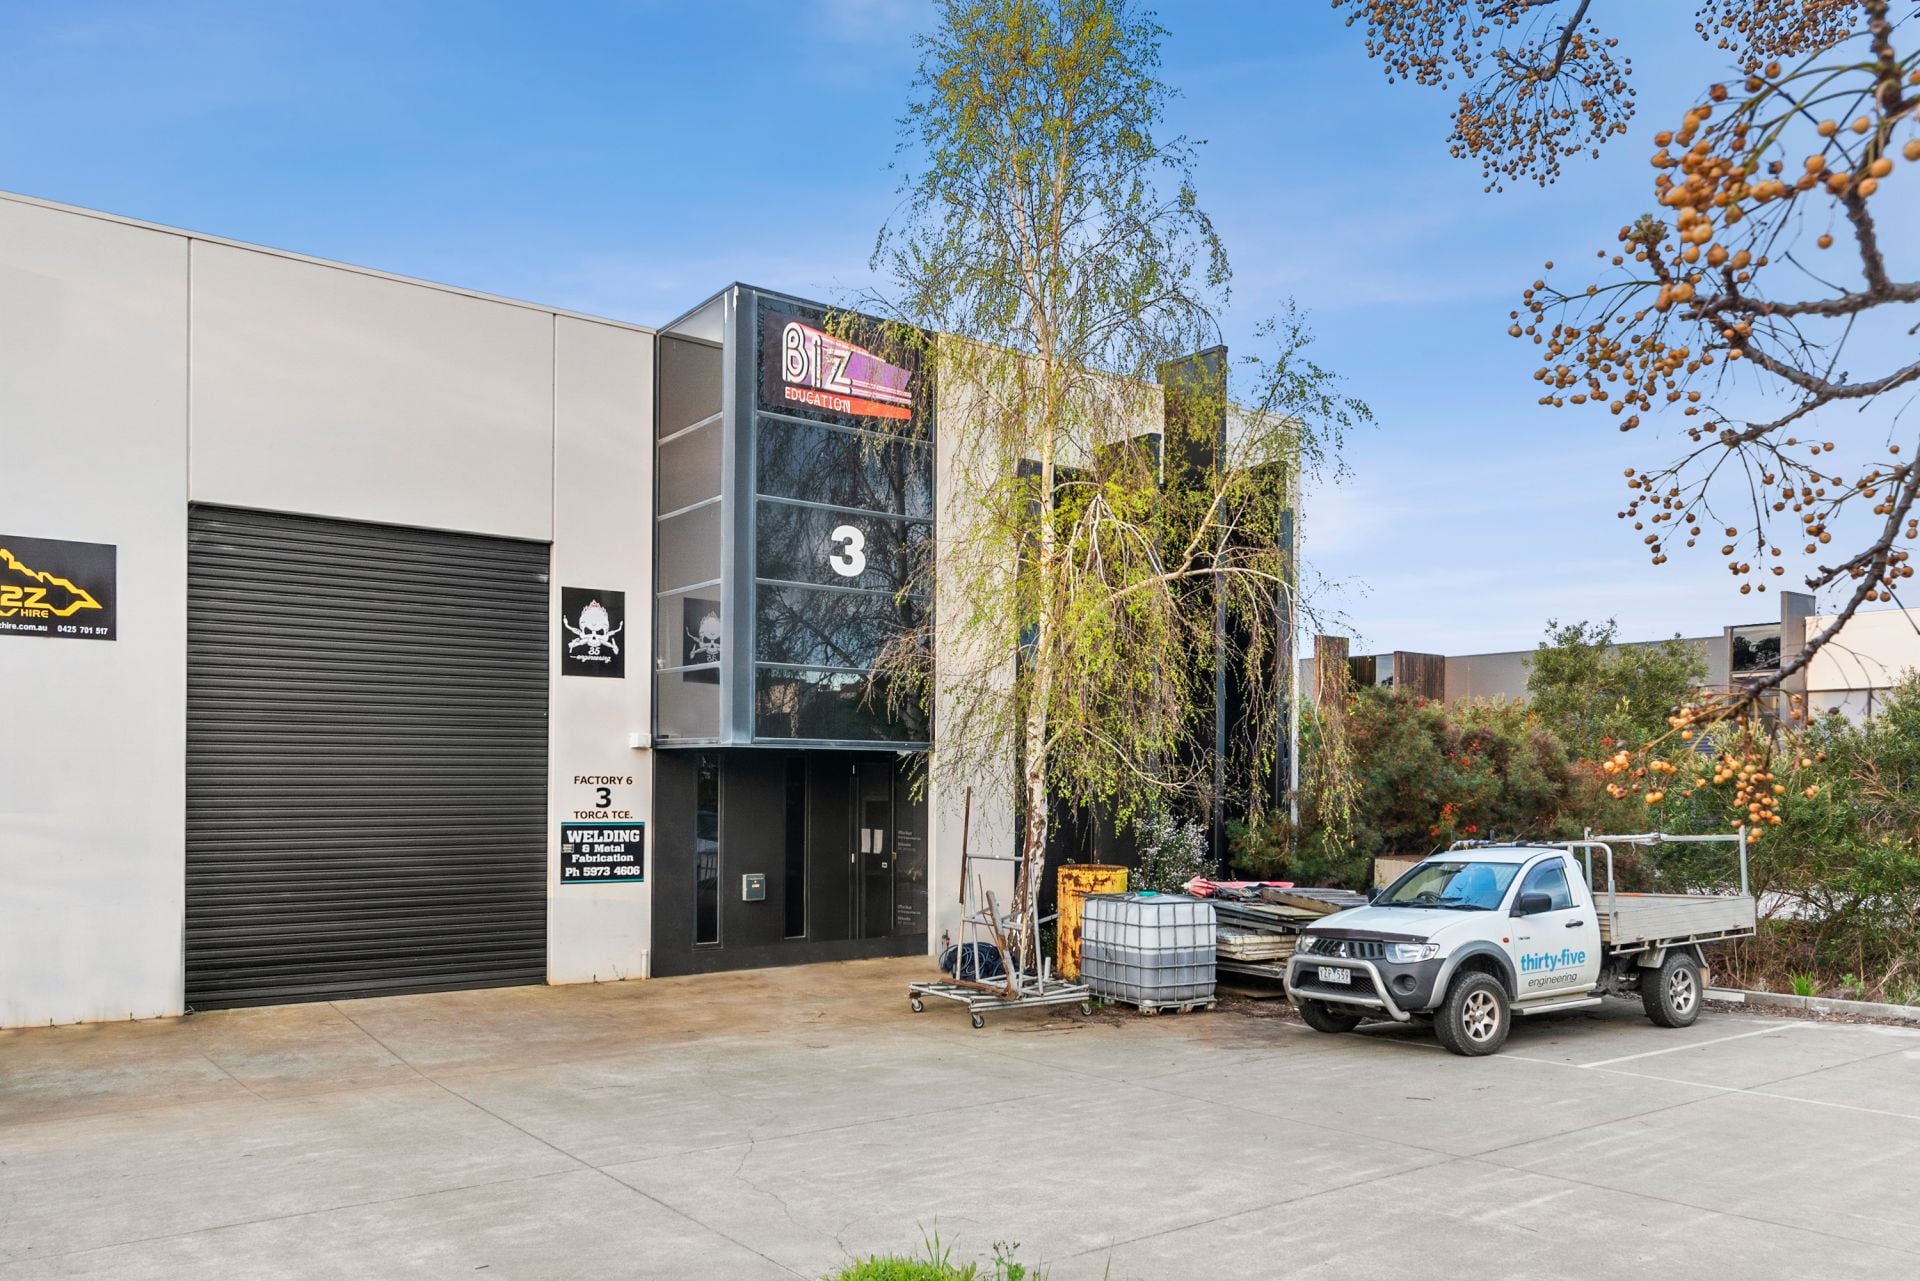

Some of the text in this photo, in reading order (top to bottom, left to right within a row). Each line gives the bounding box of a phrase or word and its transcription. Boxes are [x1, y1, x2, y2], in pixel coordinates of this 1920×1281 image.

[784, 386, 851, 414] EDUCATION
[830, 525, 866, 577] 3
[20, 608, 49, 618] HIRE
[57, 625, 77, 633] 0425
[95, 627, 108, 635] 517
[574, 775, 633, 785] FACTORY 6
[595, 787, 612, 808] 3
[573, 811, 633, 819] TORCA TCE.
[566, 830, 640, 843] WELDING
[581, 844, 590, 853] &
[593, 844, 625, 853] Metal
[571, 854, 634, 863] Fabrication
[565, 866, 641, 877] Ph 5973 4606
[1520, 948, 1586, 972] thirty-five
[1528, 973, 1577, 988] engineering
